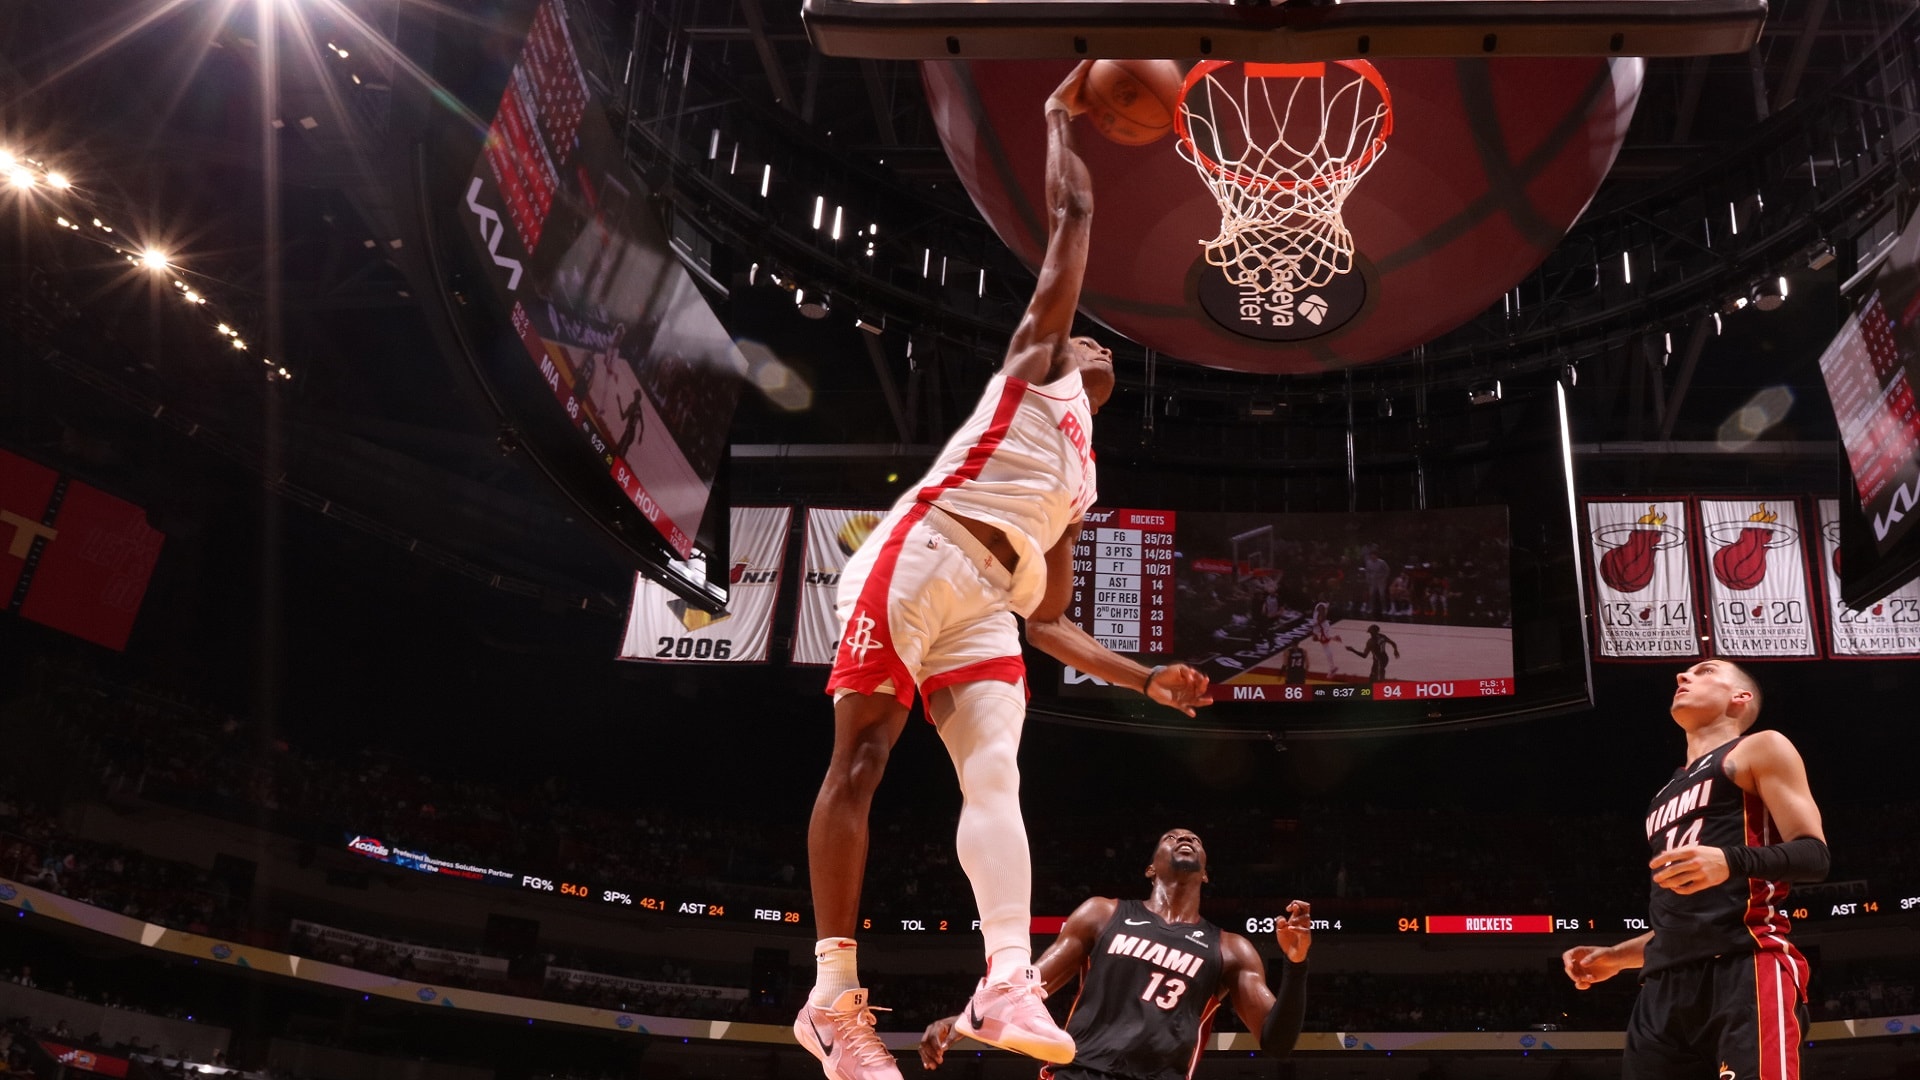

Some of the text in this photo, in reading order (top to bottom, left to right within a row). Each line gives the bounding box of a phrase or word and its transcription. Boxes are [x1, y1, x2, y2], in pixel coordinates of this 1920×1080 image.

[540, 354, 560, 392] MIA
[567, 396, 579, 418] 86
[617, 467, 630, 488] 94
[635, 487, 659, 521] HOU
[1083, 511, 1114, 523] EAT
[1130, 514, 1165, 525] ROCKETS
[1113, 531, 1126, 542] FG
[1144, 533, 1173, 545] 35/73
[1105, 546, 1112, 556] 3
[1114, 547, 1133, 557] PTS
[1144, 549, 1172, 560] 14/26
[1112, 561, 1125, 572] FT
[1145, 564, 1171, 575] 10/21
[1073, 576, 1163, 590] 24 AST 14
[1075, 591, 1163, 605] 5 OFF REB 14
[1075, 607, 1082, 617] 8
[1110, 608, 1121, 618] CH
[1123, 608, 1138, 619] PTS
[1150, 610, 1164, 621] 23
[1604, 602, 1688, 626] 13 14
[1719, 600, 1803, 625] 19 20
[1890, 599, 1920, 622] 23
[1111, 624, 1163, 637] TO 13
[656, 637, 732, 660] 2006
[1110, 640, 1117, 649] IN
[1118, 640, 1138, 651] PAINT
[1149, 641, 1163, 652] 34
[1606, 640, 1692, 651] CHAMPIONS
[1722, 638, 1807, 650] CHAMPIONS
[1480, 680, 1499, 688] FLS:
[1233, 686, 1265, 700] MIA
[1285, 687, 1303, 699] 86
[1332, 688, 1355, 697] 6:37
[1383, 685, 1402, 698] 94
[1416, 683, 1454, 697] HOU
[1646, 779, 1713, 840] MIAMI
[1665, 818, 1704, 853] 14
[393, 847, 514, 879] Preferred Business Solutions Partner
[427, 864, 439, 873] the
[522, 875, 588, 897] FG% 54.0
[603, 890, 665, 911] 3P% 42.1
[679, 902, 724, 916] AST 24
[754, 908, 800, 923] REB 28
[1792, 908, 1808, 919] 40
[1831, 903, 1857, 916] AST
[1863, 901, 1879, 913] 14
[863, 919, 871, 929] 5
[901, 920, 925, 931] TOL
[939, 921, 947, 930] 2
[1246, 917, 1278, 933] 6:3
[1334, 920, 1342, 930] 4
[1398, 918, 1649, 931] 94 ROCKETS FLS 1 TOL
[1107, 933, 1204, 978] MIAMI
[1141, 972, 1186, 1010] 13
